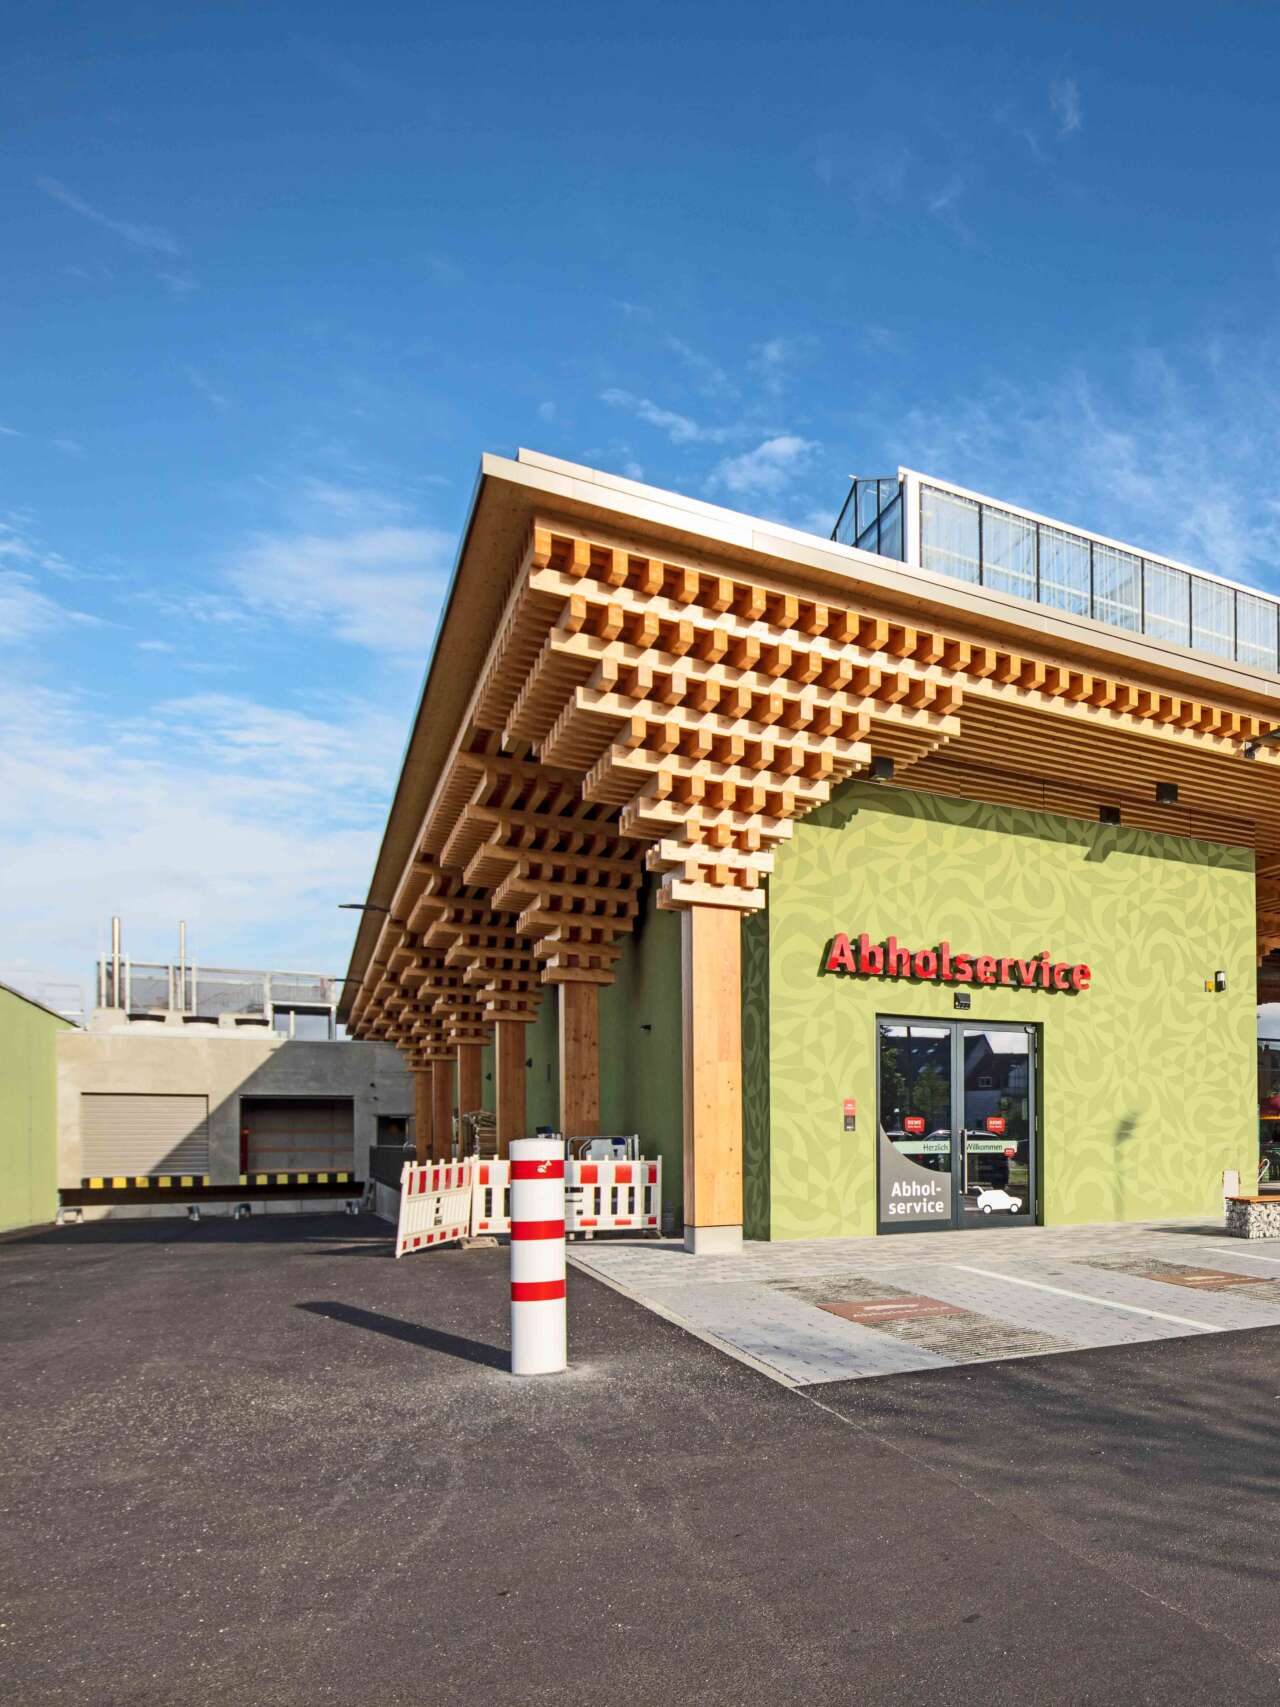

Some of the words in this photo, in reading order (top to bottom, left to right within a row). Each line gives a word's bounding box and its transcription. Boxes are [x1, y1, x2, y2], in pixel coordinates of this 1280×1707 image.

[826, 932, 1093, 991] Abholservice
[923, 1143, 949, 1152] Herzlich
[891, 1181, 942, 1197] Abhol-
[888, 1198, 945, 1215] service
